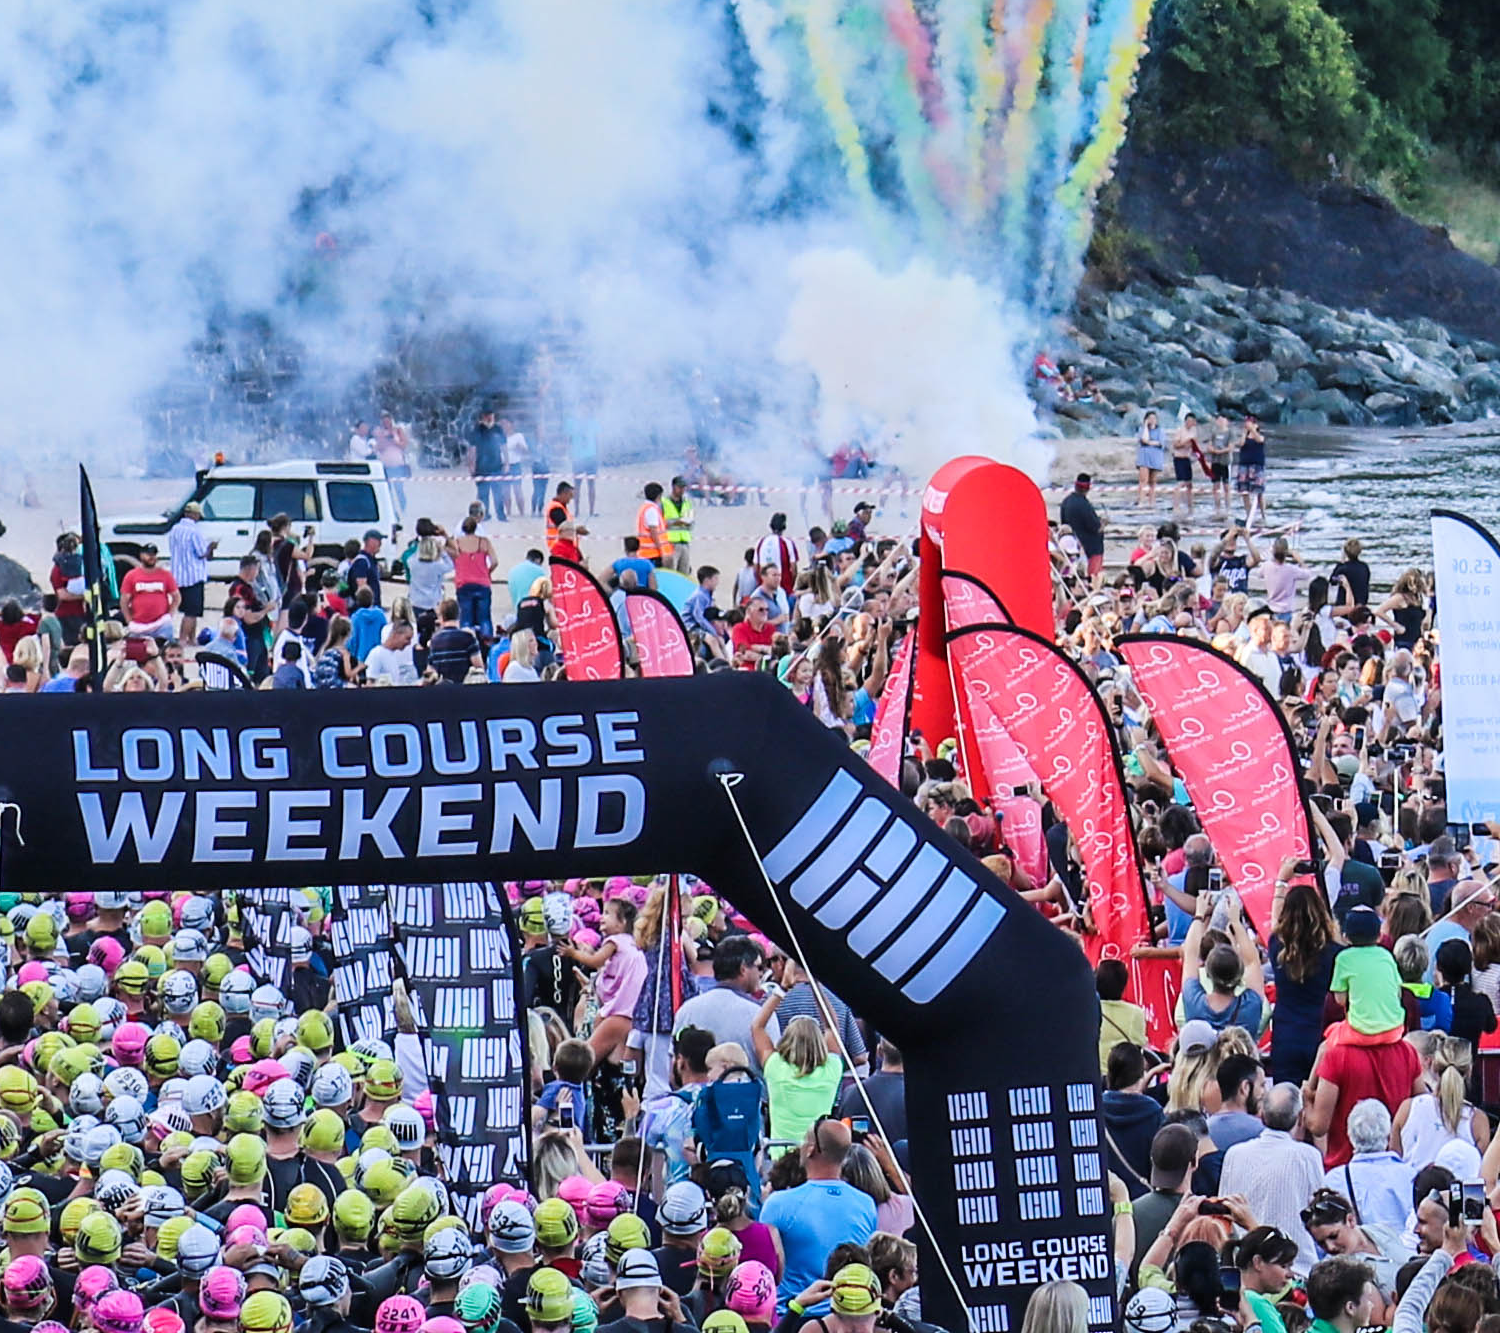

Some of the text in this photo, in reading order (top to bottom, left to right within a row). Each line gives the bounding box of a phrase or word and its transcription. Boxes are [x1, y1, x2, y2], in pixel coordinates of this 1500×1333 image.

[72, 711, 645, 782] LONG COURSE
[76, 773, 646, 864] WEEKEND
[962, 1234, 1107, 1263] LONG COURSE
[964, 1253, 1109, 1288] WEEKEND
